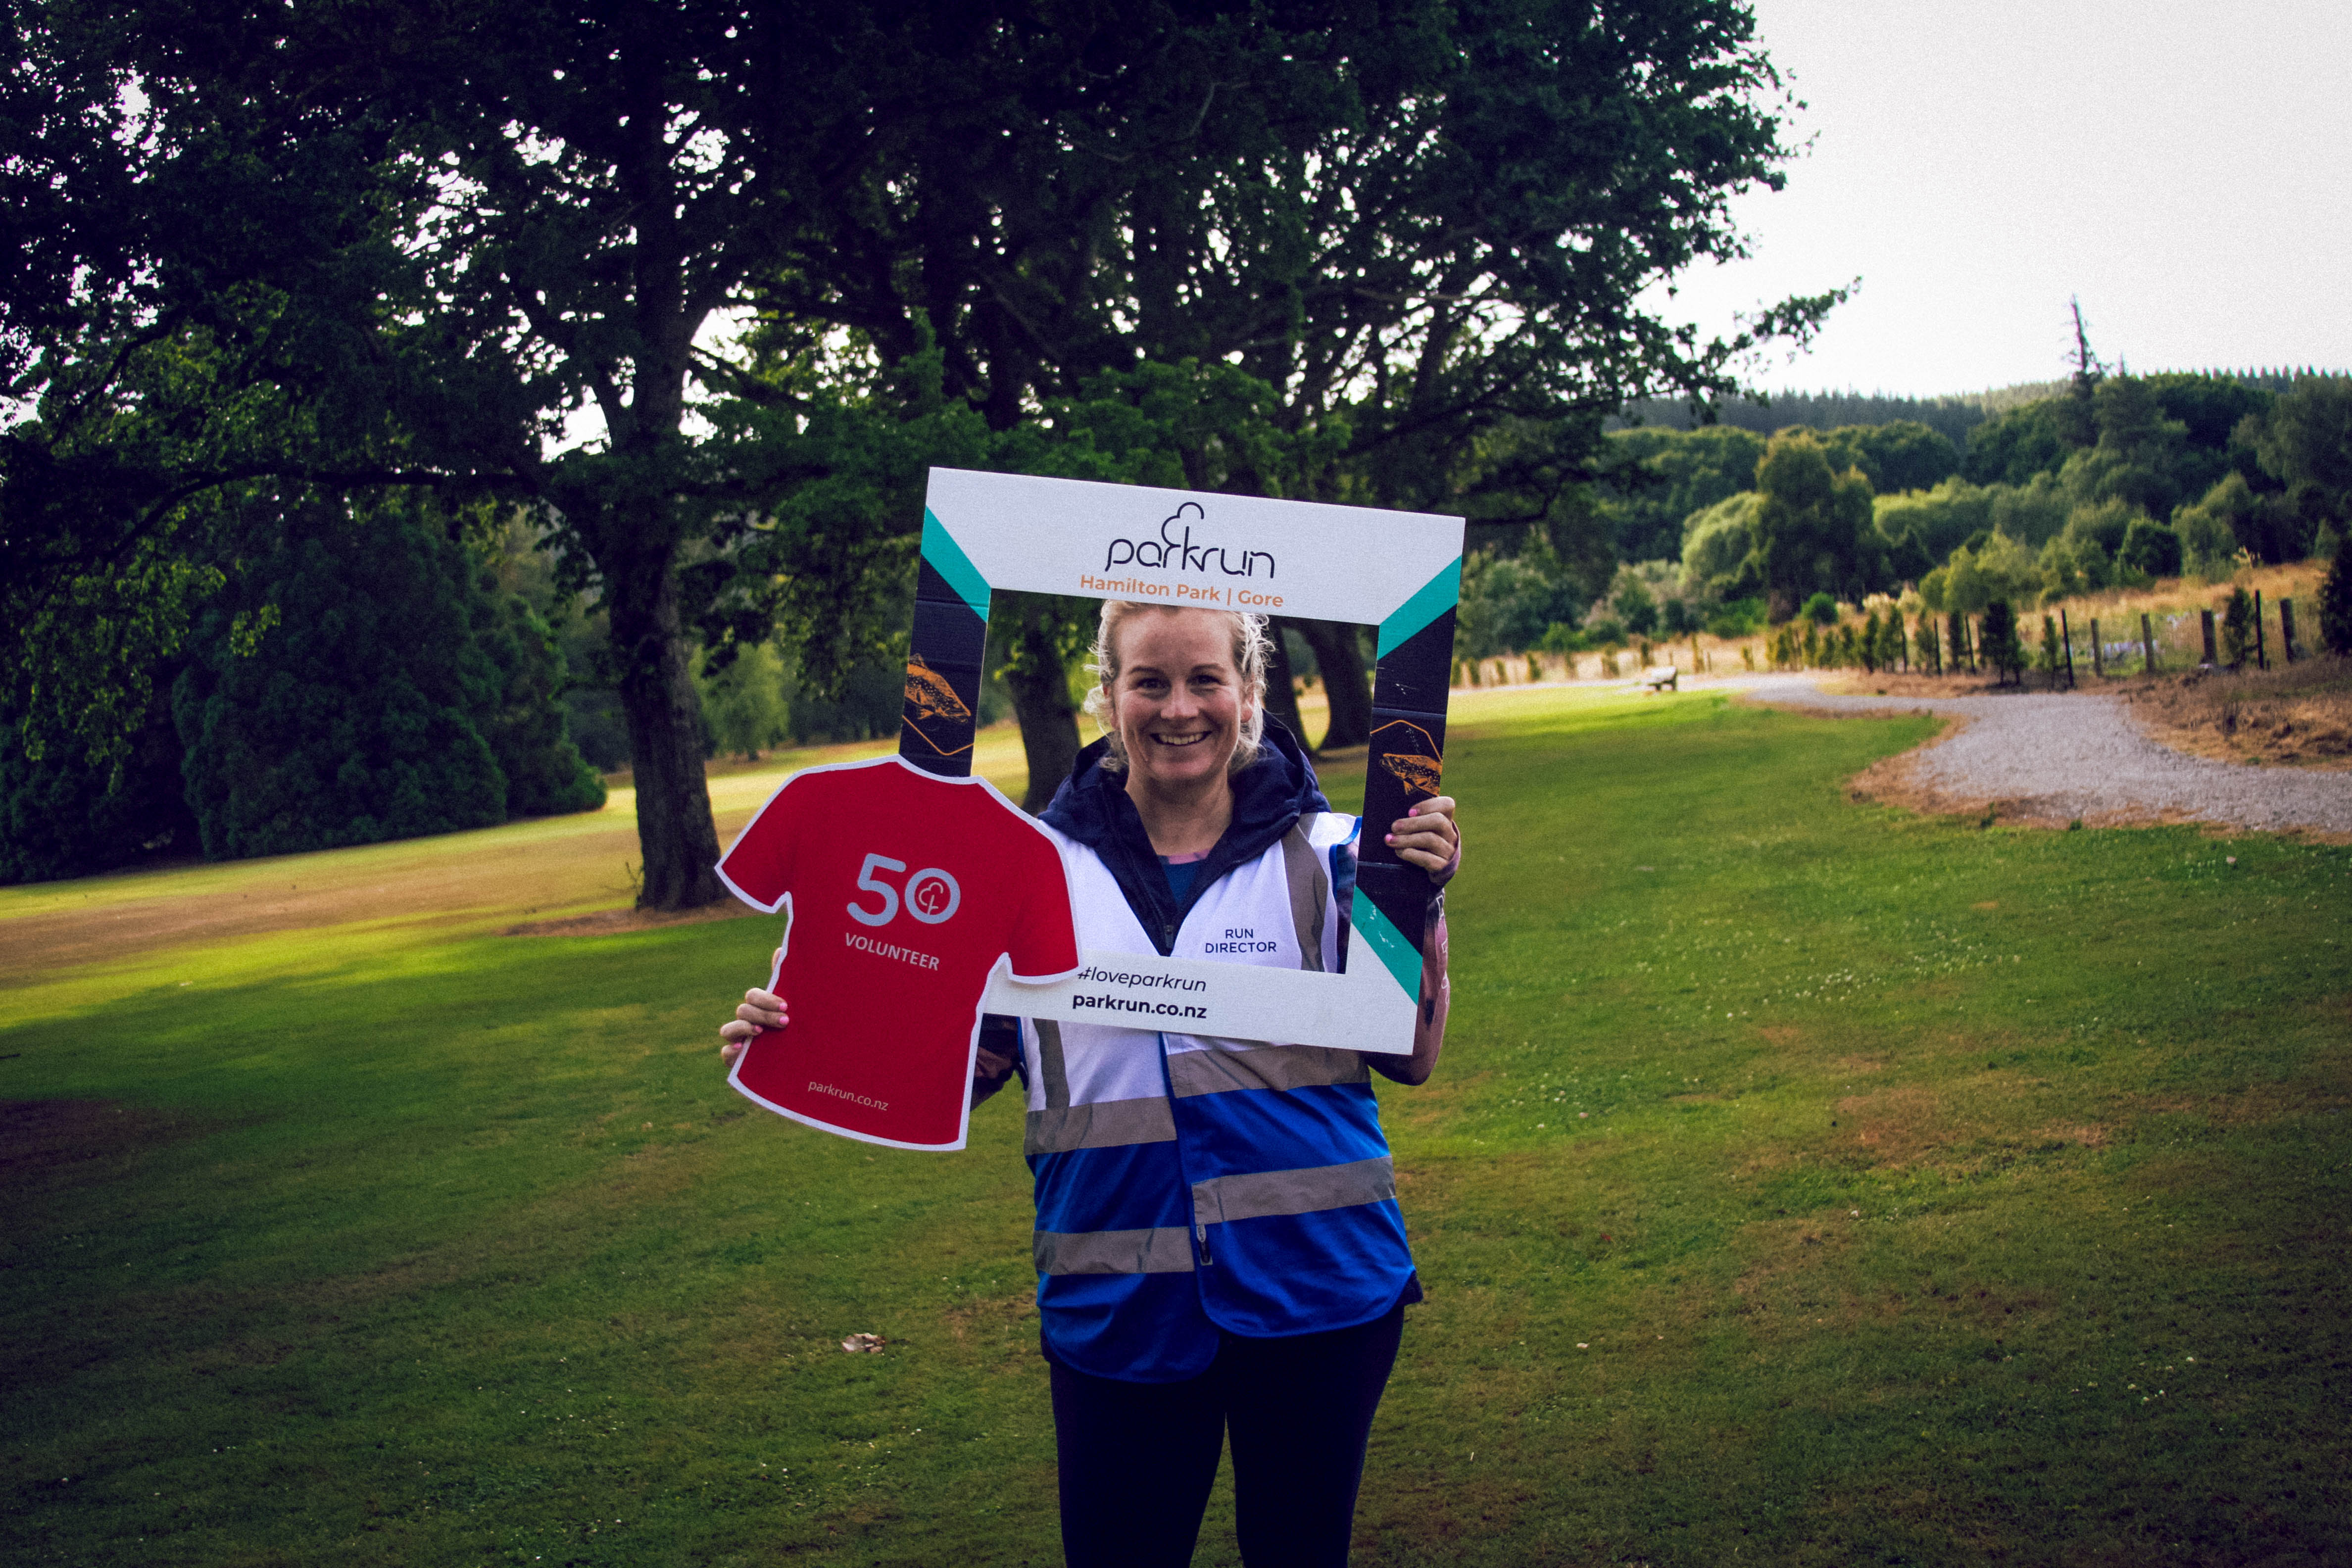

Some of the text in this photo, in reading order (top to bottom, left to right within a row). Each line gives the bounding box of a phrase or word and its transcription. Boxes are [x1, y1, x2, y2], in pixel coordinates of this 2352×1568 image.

[1105, 502, 1275, 579] parkrun
[1080, 575, 1170, 596] Hamilton
[1176, 584, 1220, 601] Park
[1238, 590, 1284, 607] Gore
[847, 853, 961, 927] 50
[1205, 941, 1277, 953] DIRECTOR
[1225, 928, 1254, 939] RUN
[845, 932, 940, 971] VOLUNTEER
[1077, 967, 1207, 992] #loveparkrun
[1072, 994, 1208, 1019] parkrun.co.nz
[807, 1081, 889, 1111] parkrun.co.nz
